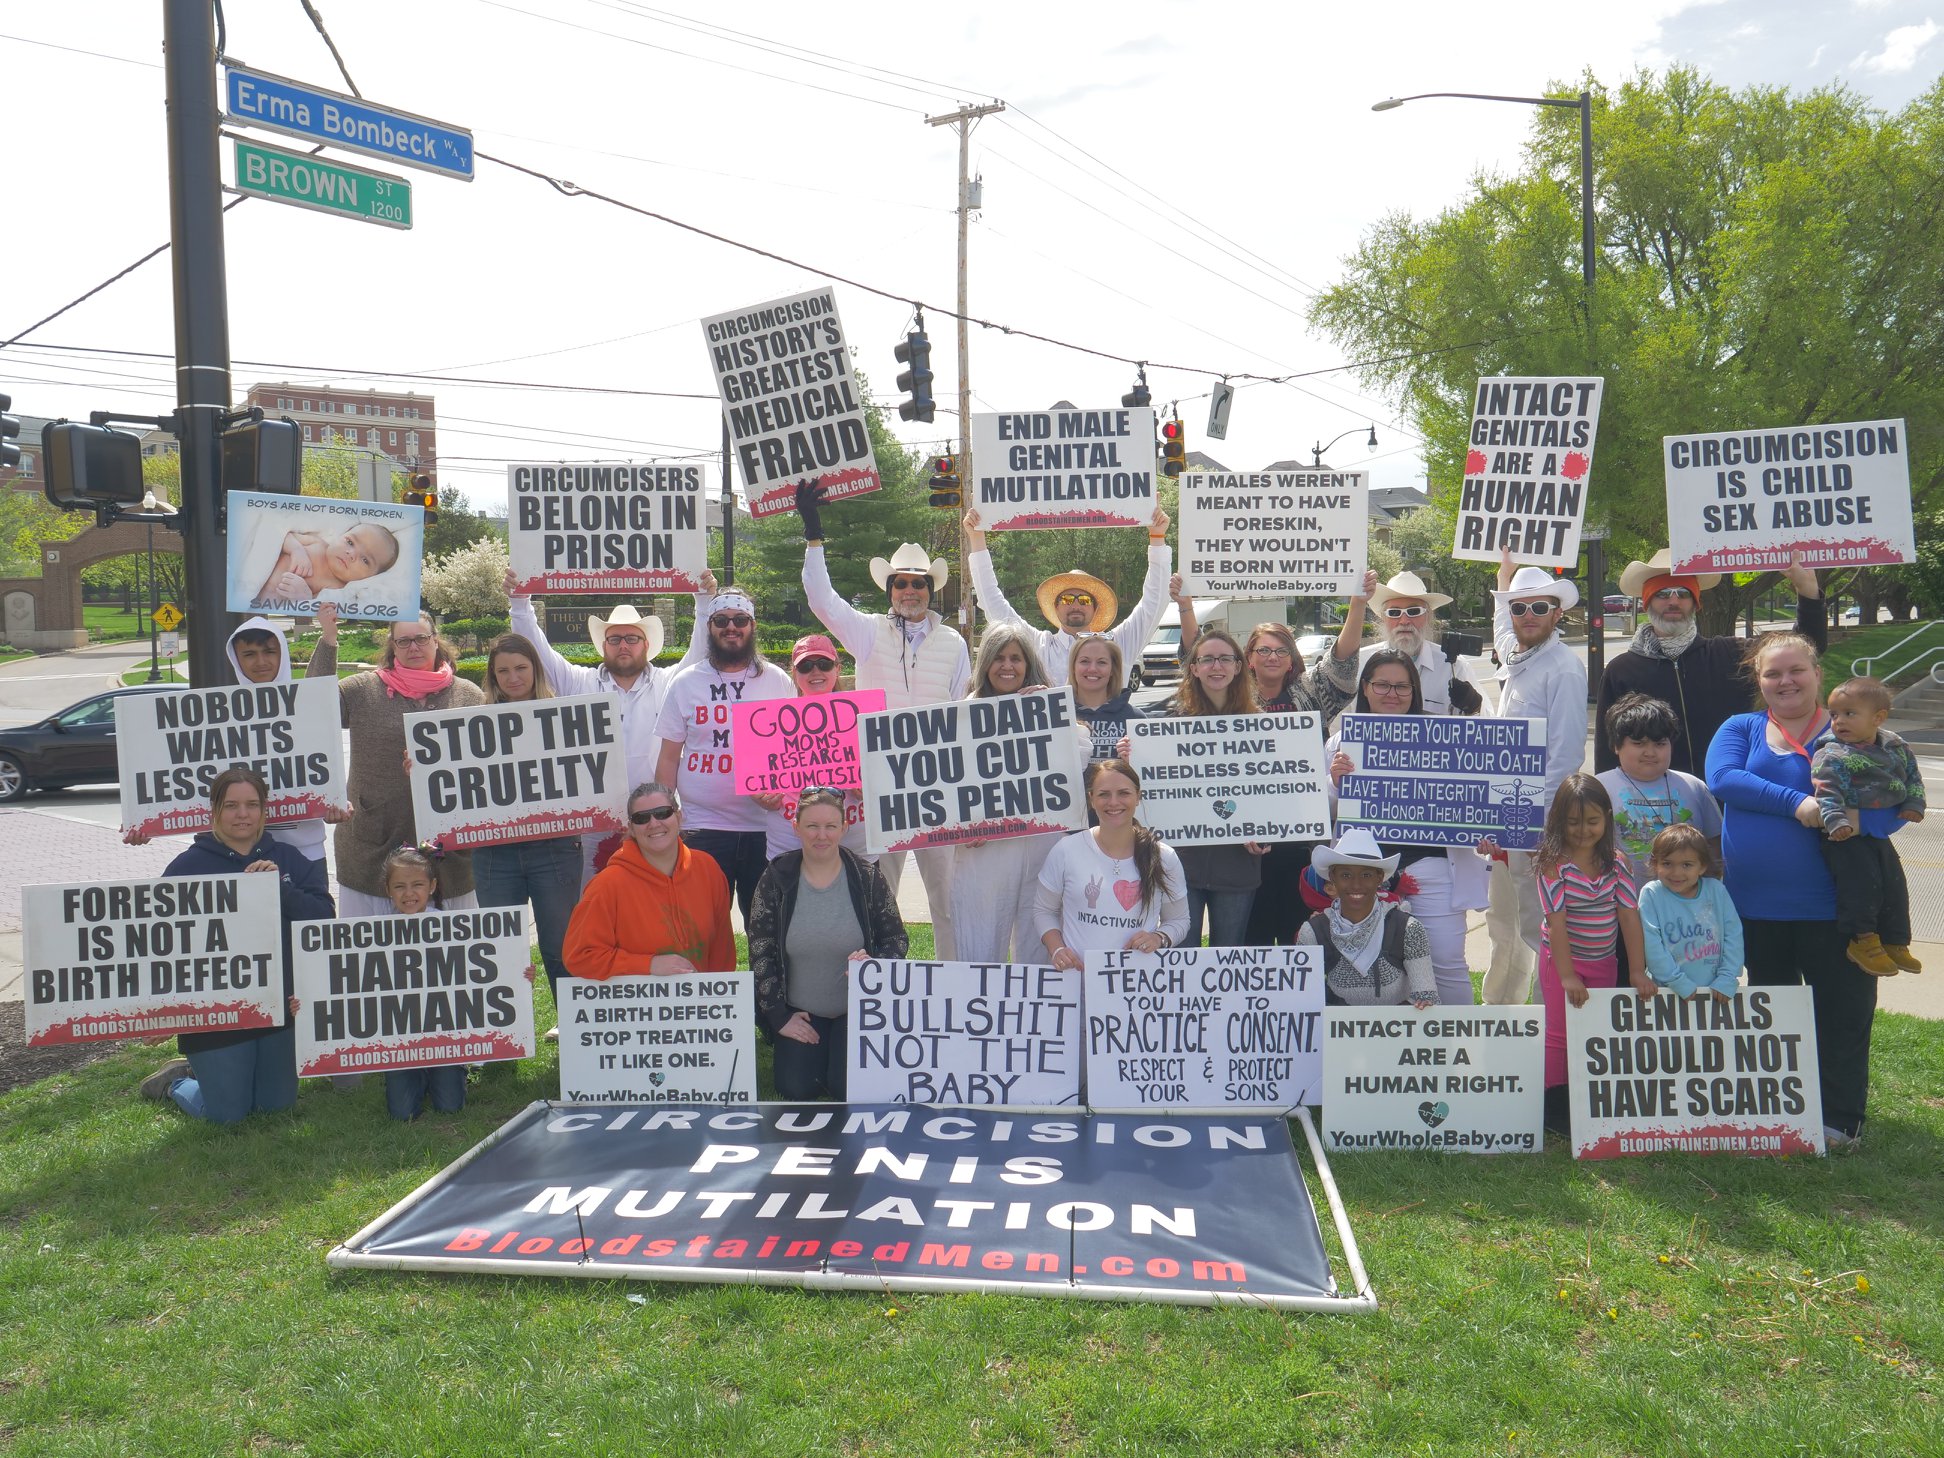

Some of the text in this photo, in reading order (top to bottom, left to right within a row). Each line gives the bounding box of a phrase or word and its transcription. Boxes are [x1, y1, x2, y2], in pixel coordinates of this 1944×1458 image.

[237, 80, 310, 126] Erma
[324, 104, 436, 159] Bombeck
[246, 152, 392, 206] BROWN ST
[371, 201, 402, 220] 1200
[708, 294, 833, 342] CIRCUMCISION
[713, 317, 841, 373] HISTORY'S
[722, 347, 846, 404] GREATEST
[730, 380, 860, 439] MEDICAL
[1476, 383, 1596, 416] INTACT
[999, 411, 1130, 440] END MALE
[1471, 419, 1589, 448] GENITALS
[739, 418, 869, 485] FRAUD
[1009, 442, 1121, 471] GENITAL
[1492, 452, 1556, 475] ARE A
[1671, 426, 1898, 469] CIRCUMCISION
[515, 467, 699, 492] CIRCUMCISERS
[981, 472, 1151, 503] MUTILATION
[1187, 474, 1361, 488] IF MALES WEREN'T
[1717, 464, 1852, 498] IS CHILD
[247, 499, 277, 509] BOYS
[280, 503, 300, 511] ARE
[329, 506, 358, 515] BORN
[361, 509, 405, 520] BROKEN.
[519, 495, 696, 531] BELONG IN
[1196, 495, 1350, 509] MEANT TO HAVE
[1462, 479, 1581, 517] HUMAN
[1224, 517, 1322, 532] FORESKIN,
[1703, 496, 1872, 533] SEX ABUSE
[544, 534, 673, 569] PRISON
[1195, 539, 1350, 552] THEY WOULDN'T
[1461, 516, 1571, 556] RIGHT
[1191, 560, 1354, 574] BE BORN WITH IT.
[547, 578, 672, 590] BLOODSTAINEDMEN.COM
[1206, 580, 1337, 592] YourWholeBaby.org
[156, 684, 299, 730] NOBODY
[710, 682, 745, 701] MY
[413, 702, 614, 765] STOP THE
[750, 699, 859, 737] GOOD
[865, 692, 1070, 752] HOW DARE
[1135, 716, 1314, 736] GENITALS SHOULD
[166, 720, 294, 765] WANTS
[768, 746, 856, 770] RESEARCH
[784, 731, 840, 753] MOMS
[1178, 740, 1275, 756] NOT HAVE
[887, 734, 1052, 790] YOU CUT
[1142, 760, 1315, 780] NEEDLESS SCARS.
[136, 764, 218, 805] LESS
[428, 751, 608, 814] CRUELTY
[1141, 782, 1321, 800] RETHINK CIRCUMCISION.
[879, 773, 1071, 832] HIS PENIS
[456, 817, 593, 844] BLOODSTAINEDMEN.COM
[63, 879, 238, 923] FORESKIN
[301, 910, 521, 952] CIRCUMCISION
[1078, 911, 1144, 928] INTACTIVISM
[1664, 917, 1704, 944] Elsa
[78, 919, 228, 961] IS NOT A
[329, 943, 498, 995] HARMS
[1104, 949, 1309, 968] IF YOU WANT TO
[33, 953, 272, 1004] BIRTH DEFECT
[572, 981, 739, 1000] FORESKIN IS NOT
[859, 960, 1063, 999] CUT THE
[1098, 967, 1312, 994] TEACH CONSENT
[314, 986, 516, 1042] HUMANS
[575, 1005, 737, 1023] A BIRTH DEFECT.
[860, 998, 1077, 1036] BULLSHIT
[1124, 996, 1270, 1011] YOU HAVE TO
[1610, 992, 1772, 1032] GENITALS
[72, 1011, 238, 1037] BLOODSTAINEDMEN.COM
[581, 1028, 733, 1046] STOP TREATING
[1090, 1011, 1321, 1055] PRACTICE CONSENT.
[1330, 1020, 1539, 1038] INTACT GENITALS
[340, 1042, 493, 1067] BLOODSTAINEDMEN.COM
[600, 1053, 715, 1069] IT LIKE ONE.
[860, 1034, 1065, 1075] NOT THE
[1118, 1058, 1185, 1082] RESPECT
[1229, 1057, 1293, 1081] PROTECT
[1398, 1048, 1470, 1065] ARE A
[1585, 1034, 1801, 1075] SHOULD NOT
[908, 1072, 1021, 1104] BABY
[1136, 1083, 1279, 1102] YOUR SONS
[1345, 1076, 1523, 1094] HUMAN RIGHT.
[1589, 1076, 1805, 1118] HAVE SCARS
[546, 1110, 1267, 1149] CIRCUMCISION
[1331, 1130, 1535, 1149] YourWholeBaby.org
[1620, 1136, 1781, 1152] BLOODSTAINEDMEN.COM
[689, 1144, 1064, 1185] PENIS
[522, 1186, 1197, 1237] MUTILATION
[444, 1228, 1247, 1282] BloodstainedMen.com
